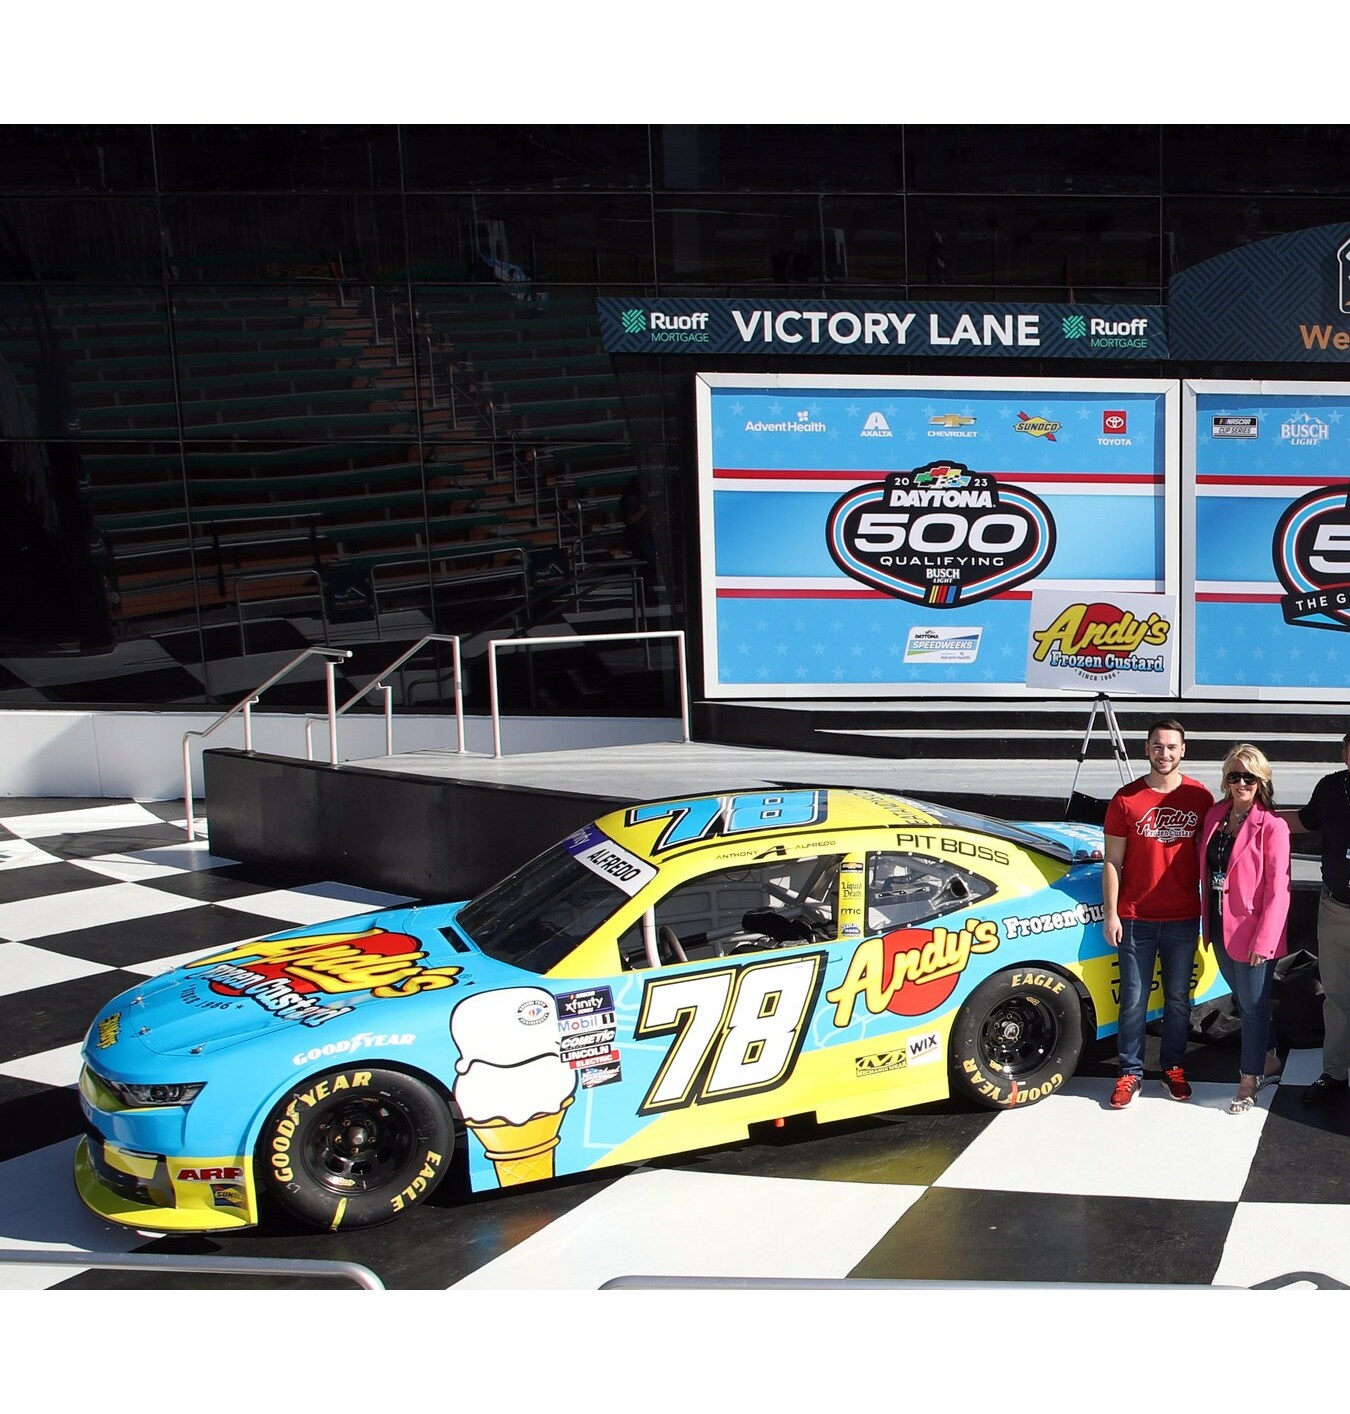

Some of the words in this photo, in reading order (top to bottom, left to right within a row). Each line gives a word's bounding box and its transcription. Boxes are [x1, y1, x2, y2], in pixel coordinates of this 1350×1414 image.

[650, 312, 709, 330] Ruoff
[731, 310, 917, 345] VICTORY
[929, 314, 1041, 347] LANE
[1090, 318, 1148, 336] Ruoff
[650, 332, 710, 343] MORTGAGE
[1090, 338, 1148, 348] MORTGAGE
[745, 421, 827, 433] AdventHealth
[860, 430, 894, 438] AXALTA
[1016, 422, 1060, 432] SUNOCO
[1281, 424, 1329, 439] BUSCH
[1097, 438, 1133, 446] TOYOTA
[1290, 438, 1319, 446] LIGHT
[895, 477, 910, 486] 20
[973, 478, 988, 487] 23
[889, 489, 993, 508] DAYTONA
[853, 513, 1029, 554] 500
[879, 556, 1005, 567] QUALIFYING
[926, 568, 961, 580] BUSCH
[1295, 596, 1329, 612] THE
[1033, 603, 1171, 662] Andy's
[912, 640, 974, 650] SPEEDWEEKS
[1050, 649, 1103, 669] Frozen
[1104, 652, 1165, 673] Custard
[1077, 669, 1099, 682] SINCE
[624, 790, 829, 857] 78
[1135, 807, 1198, 836] Andy's
[716, 849, 760, 860] ANTHONY
[795, 840, 837, 850] ALFREDO
[896, 833, 937, 850] PIT
[940, 840, 1010, 866] BOSS
[586, 848, 642, 882] ALFREDO
[1002, 905, 1075, 939] Frozen
[826, 918, 1001, 1029] Andy's
[1011, 973, 1067, 996] EAGLE
[565, 996, 604, 1013] xfinity
[557, 1015, 599, 1033] Mobil
[602, 1012, 613, 1025] 1
[560, 1029, 615, 1049] COMETIC
[633, 951, 828, 1117] 78
[292, 1031, 417, 1067] GOODYEAR
[561, 1044, 610, 1062] LINCOLN
[909, 1034, 938, 1055] WIX
[575, 1054, 614, 1068] ELECTRIC
[271, 1071, 373, 1184] GOODYEAR
[176, 1166, 244, 1181] ARP
[390, 1149, 443, 1213] EAGLE
